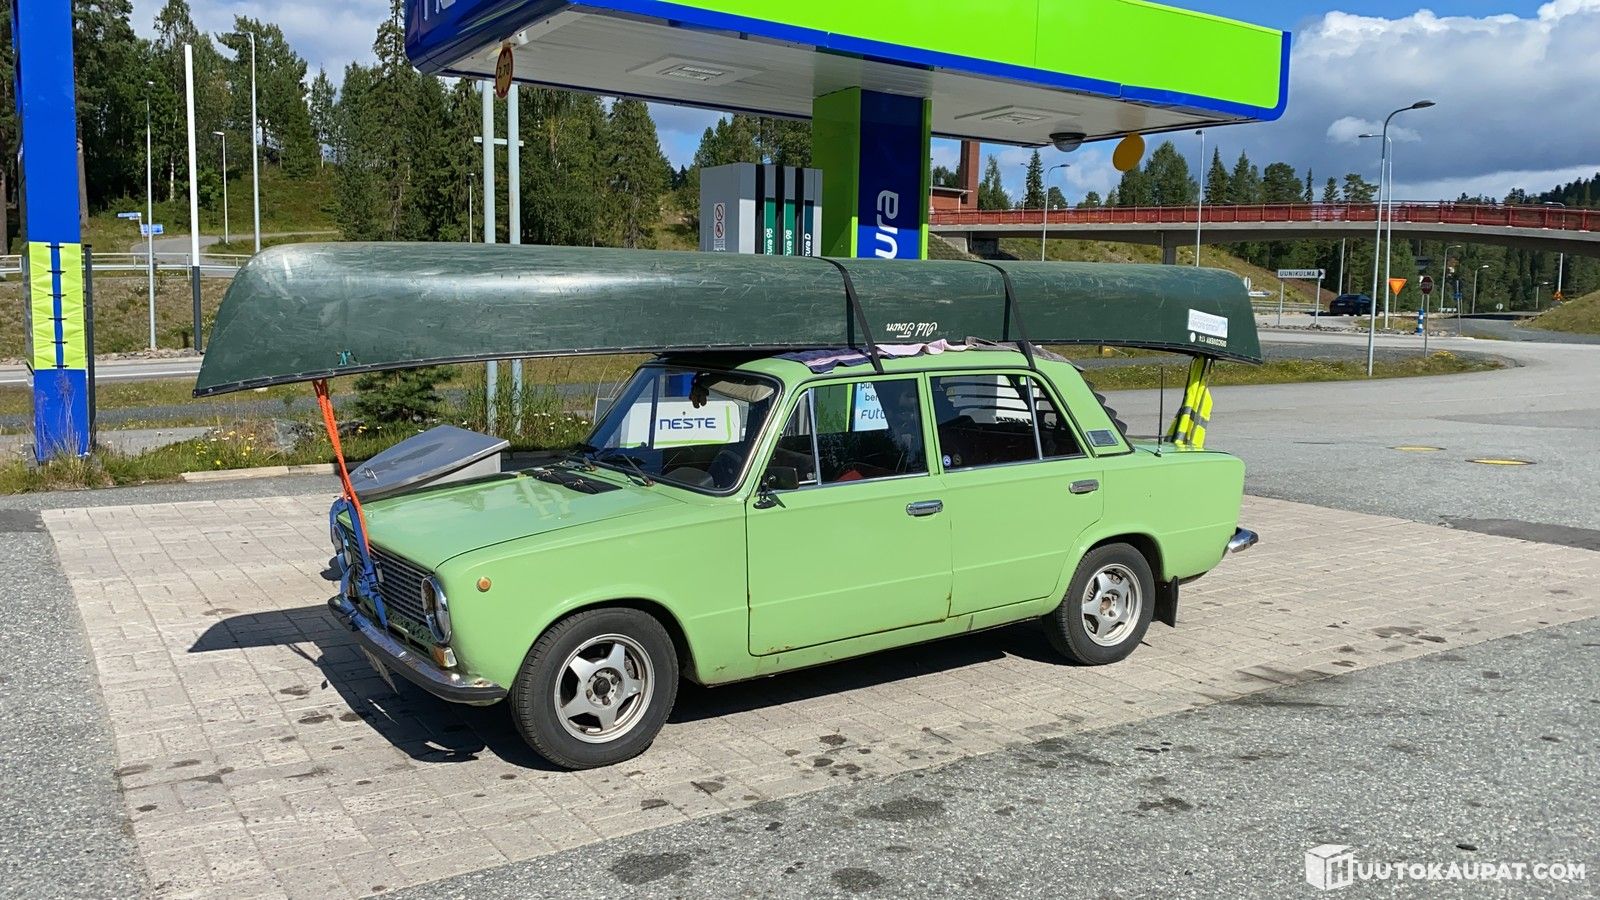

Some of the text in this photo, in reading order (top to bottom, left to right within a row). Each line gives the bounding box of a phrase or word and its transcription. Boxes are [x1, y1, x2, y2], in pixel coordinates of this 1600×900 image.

[766, 227, 774, 239] 95
[785, 229, 793, 256] ura 98
[886, 322, 938, 338] Old Town
[659, 417, 717, 430] NESTE
